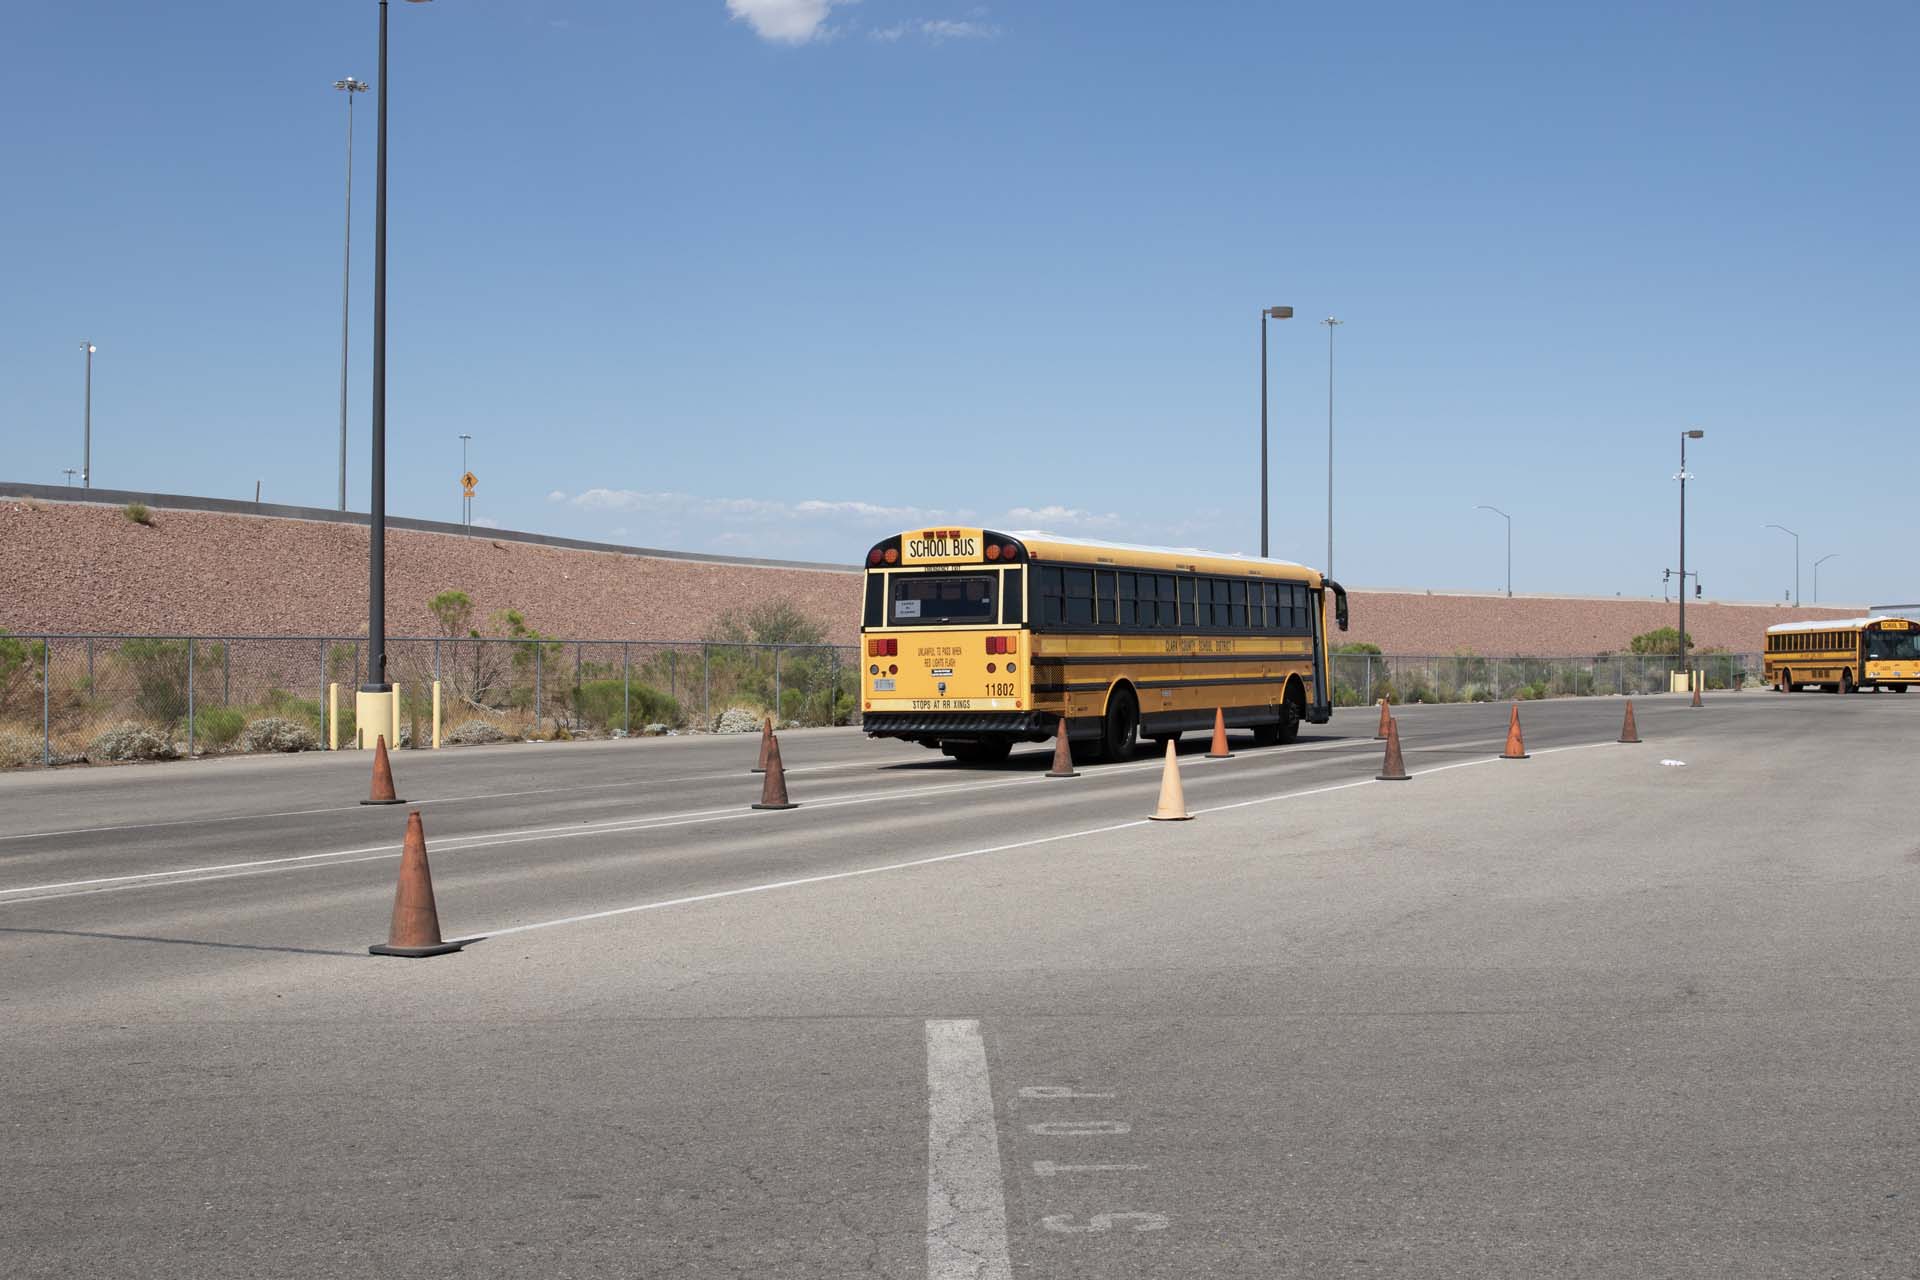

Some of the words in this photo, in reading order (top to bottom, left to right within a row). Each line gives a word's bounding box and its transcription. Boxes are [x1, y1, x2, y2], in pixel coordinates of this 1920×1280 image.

[910, 538, 950, 558] SCHOOL
[953, 538, 974, 556] BUS
[936, 647, 942, 656] TO
[924, 658, 933, 667] RED
[985, 683, 1015, 697] 11802
[912, 700, 931, 709] STOPS
[933, 700, 940, 708] AT
[943, 699, 951, 708] RR
[953, 699, 970, 708] XINGS
